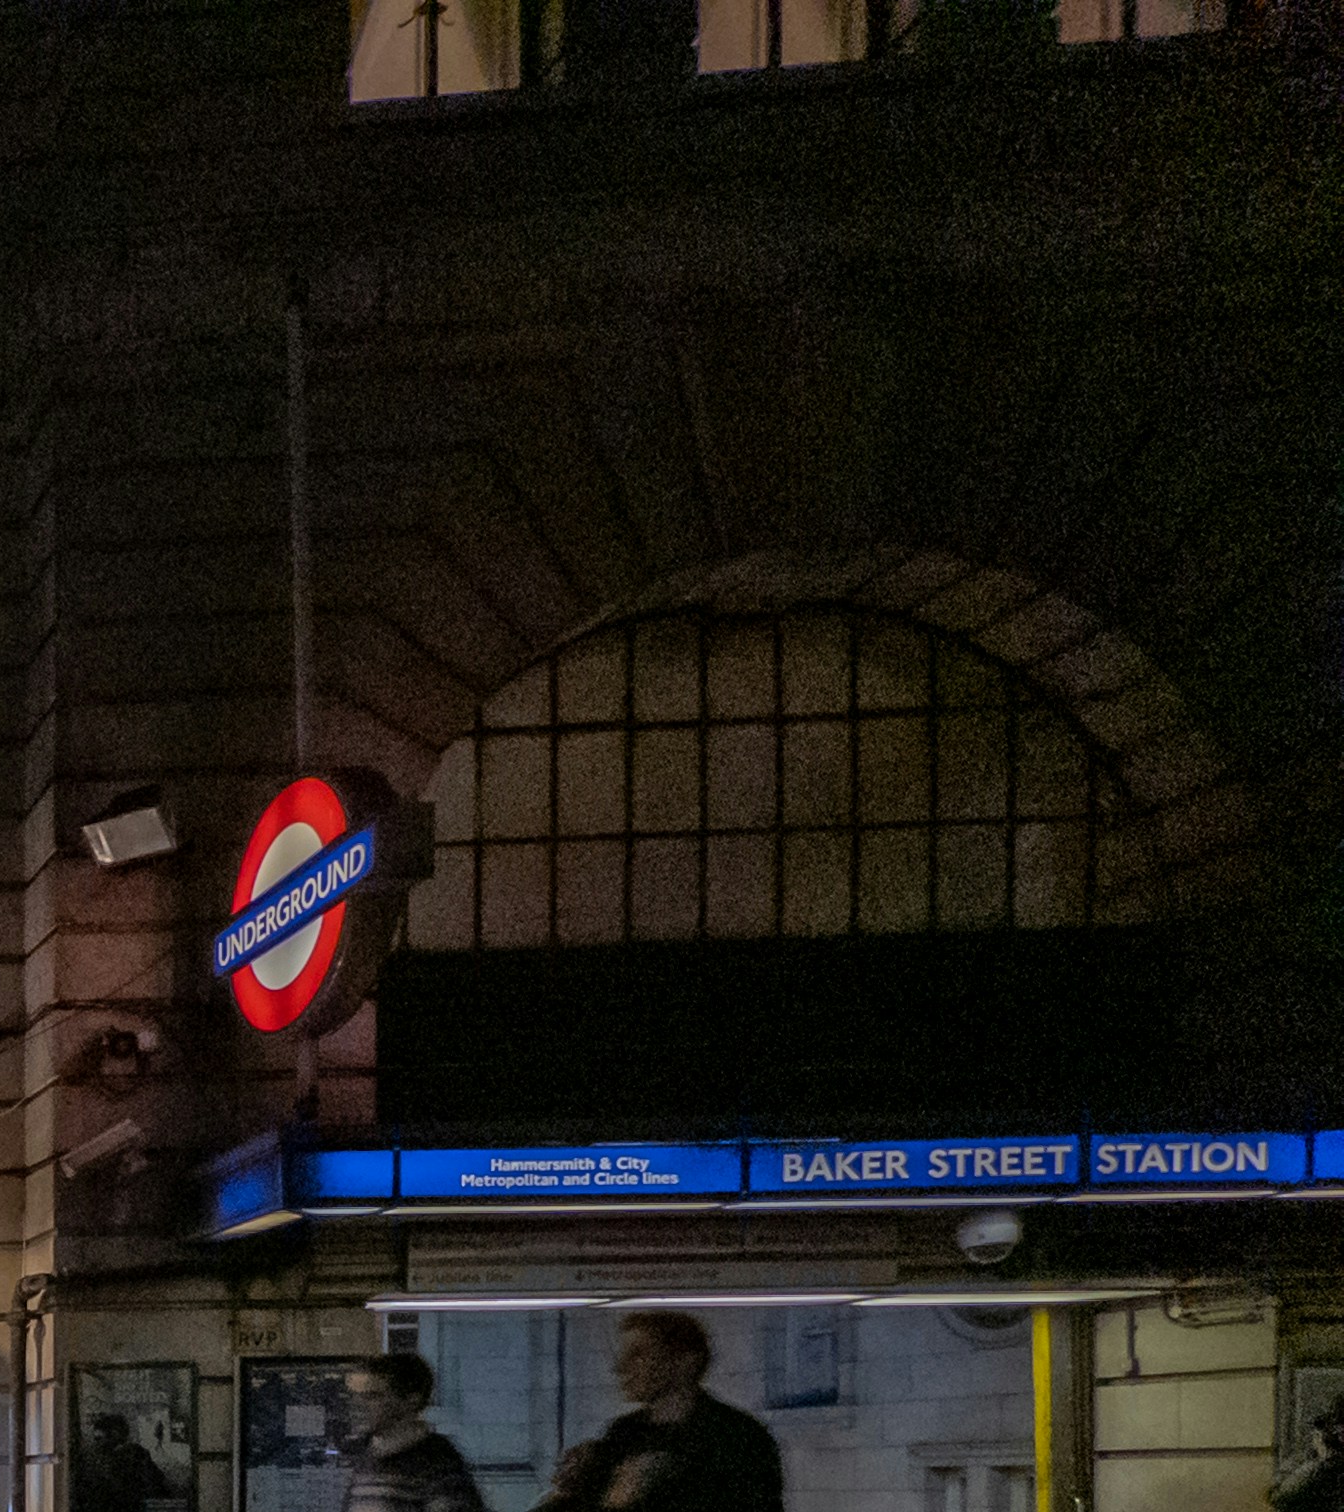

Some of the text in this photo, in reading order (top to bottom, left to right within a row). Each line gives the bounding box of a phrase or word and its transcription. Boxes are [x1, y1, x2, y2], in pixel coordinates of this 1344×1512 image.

[218, 843, 365, 967] UNDERGROUND
[490, 1156, 650, 1172] Hammersmith & City
[782, 1142, 1268, 1183] BAKER STREET STATION
[461, 1171, 679, 1188] Metropolitan and Circle lines
